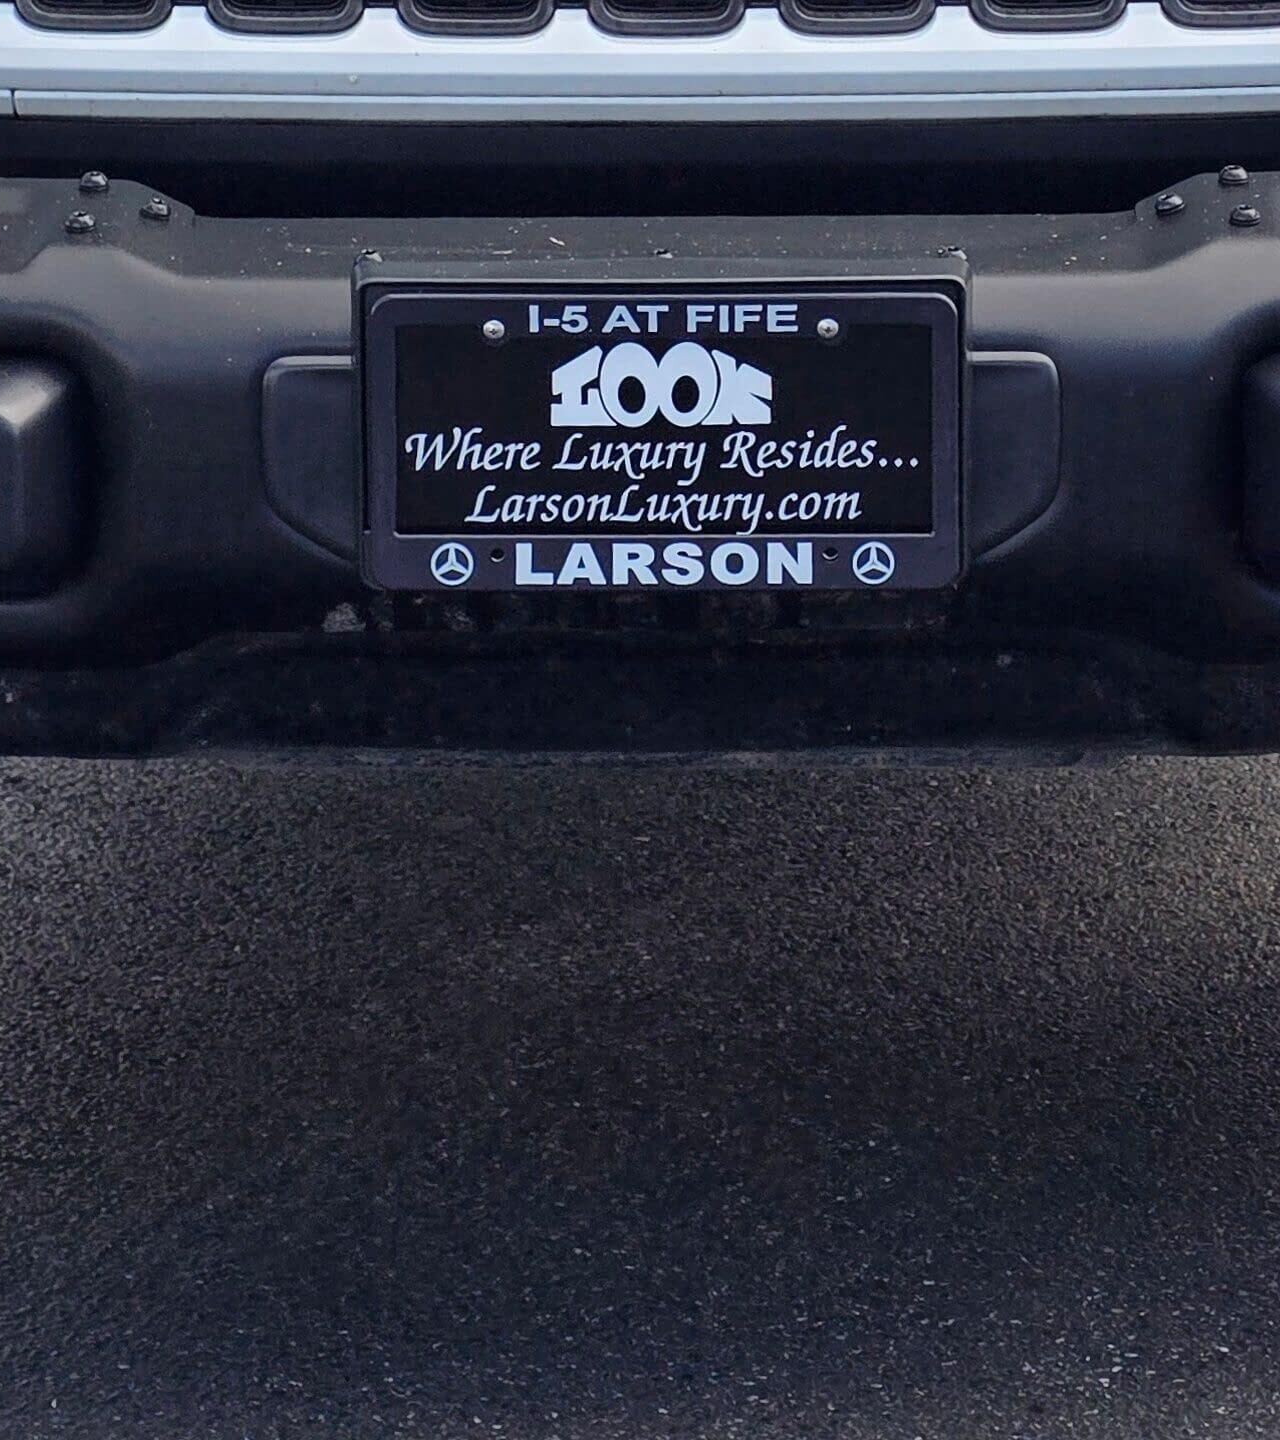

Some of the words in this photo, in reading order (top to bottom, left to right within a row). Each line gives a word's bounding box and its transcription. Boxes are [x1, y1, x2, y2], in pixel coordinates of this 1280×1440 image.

[528, 304, 590, 334] I-5
[601, 304, 669, 333] AT
[686, 303, 800, 333] FIFE
[549, 341, 773, 428] LOOK
[404, 426, 542, 471] Where
[551, 432, 707, 486] Luxury
[719, 424, 920, 478] Resides...
[463, 484, 863, 536] LarsonLuxury.com
[514, 542, 814, 586] LARSON
